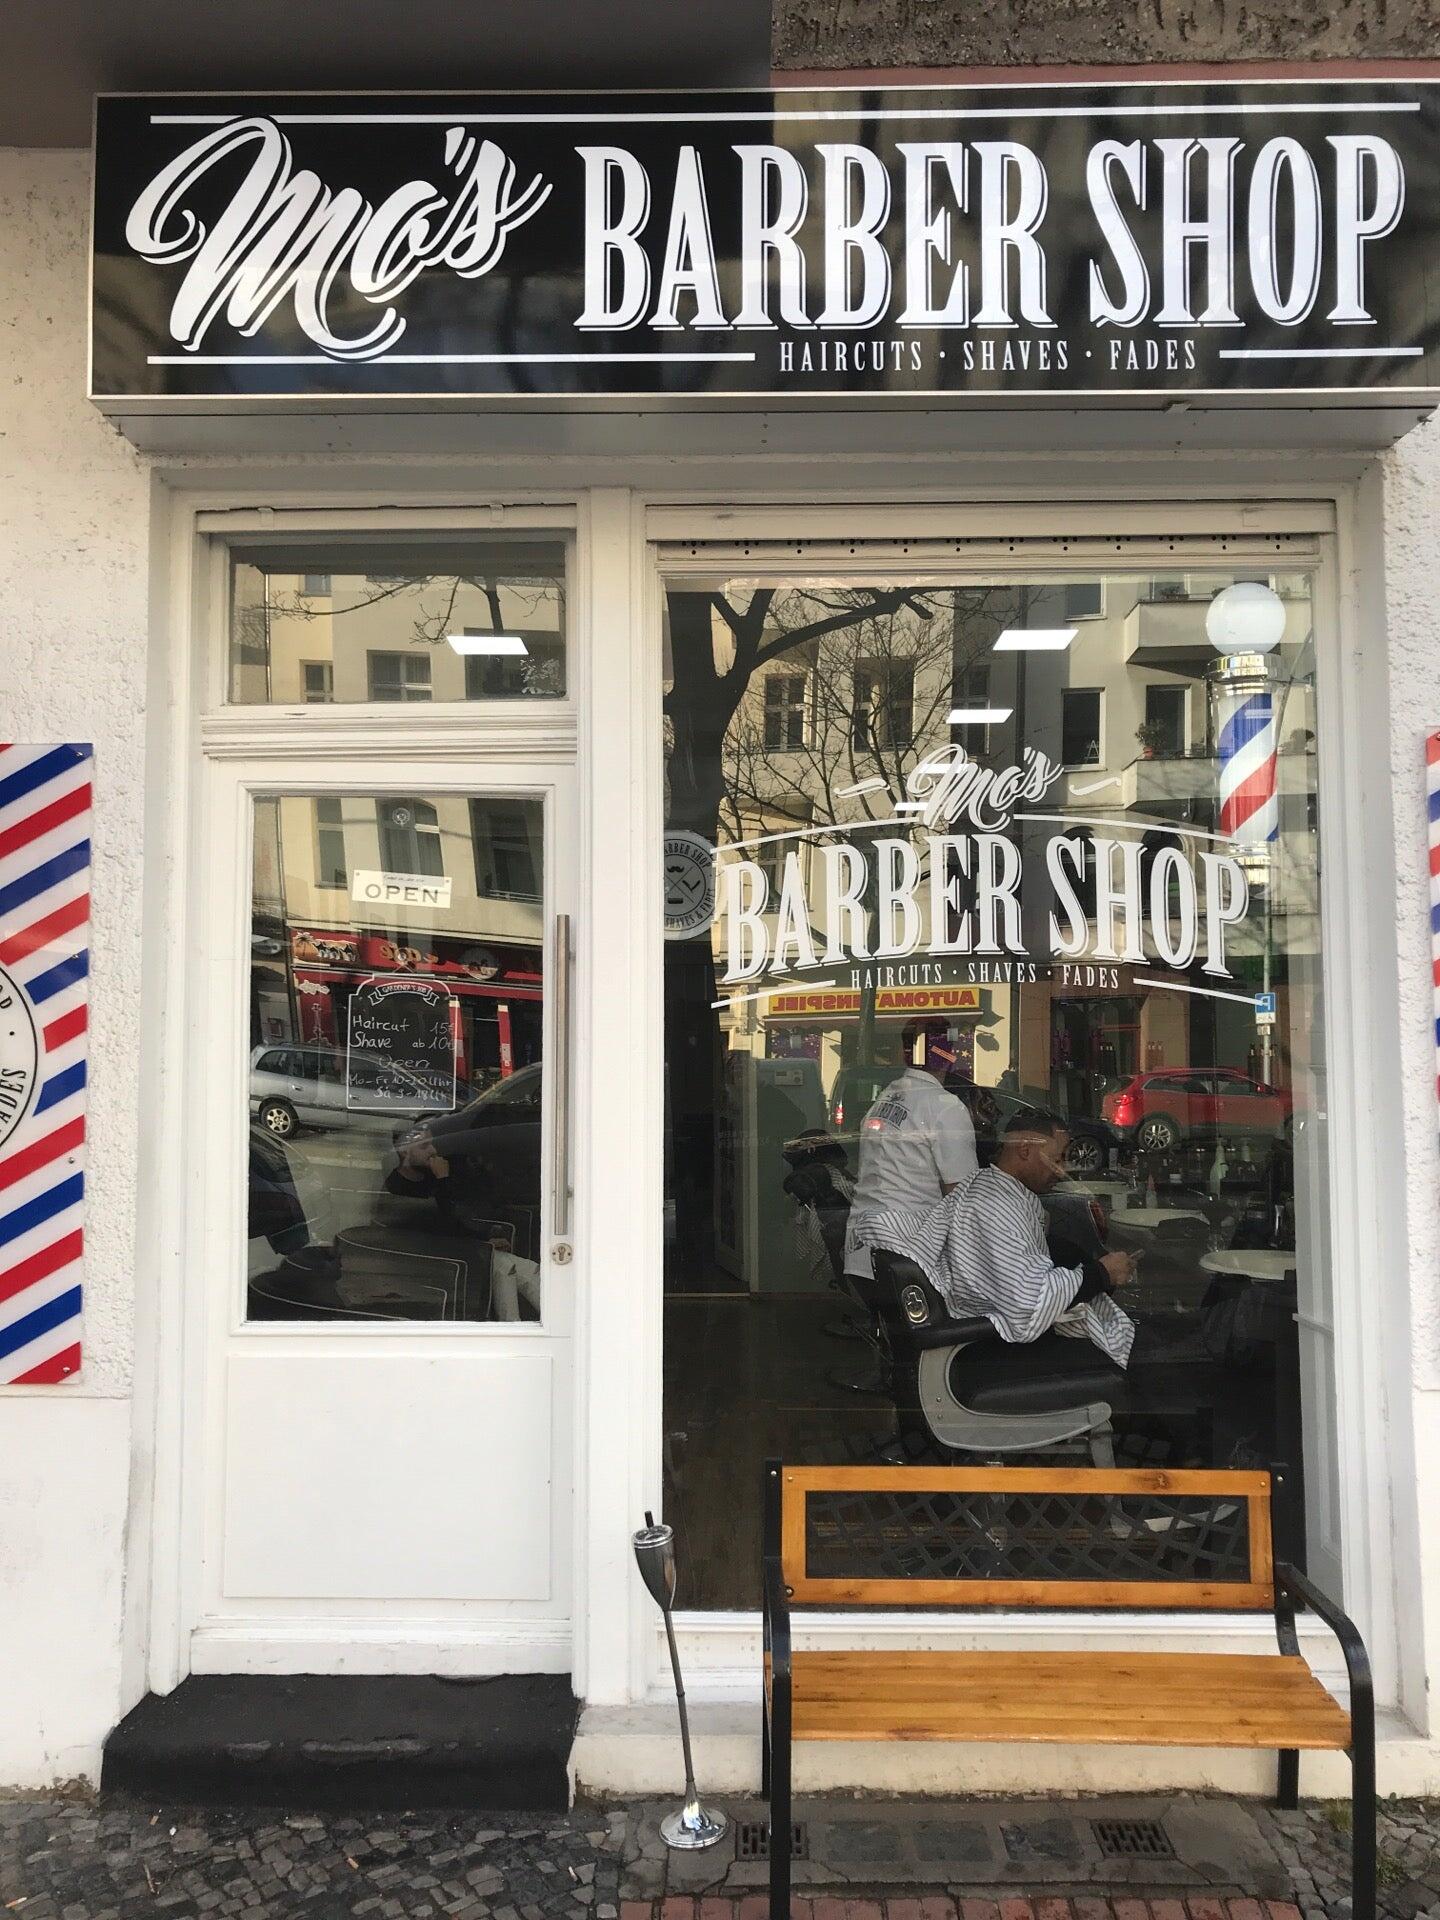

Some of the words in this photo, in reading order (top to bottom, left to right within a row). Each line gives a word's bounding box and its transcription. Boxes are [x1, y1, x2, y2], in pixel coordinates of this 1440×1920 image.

[125, 116, 553, 361] Mo's
[574, 141, 1058, 332] BARBER
[1086, 135, 1406, 329] SHOP
[779, 341, 922, 372] HAIRCUTS
[964, 340, 1069, 371] SHAVES
[1110, 339, 1197, 370] FADES
[907, 743, 1064, 832] Mo's
[366, 884, 438, 903] OPEN
[721, 834, 1030, 984] BARBER
[1046, 836, 1249, 979] SHOP
[851, 963, 942, 989] HAIRCUTS
[968, 962, 1036, 983] SHAVES
[1063, 965, 1119, 988] FADES
[349, 1031, 392, 1048] Shave
[412, 1038, 425, 1048] ab
[353, 1015, 410, 1032] Haircut
[0, 1068, 27, 1133] ADES
